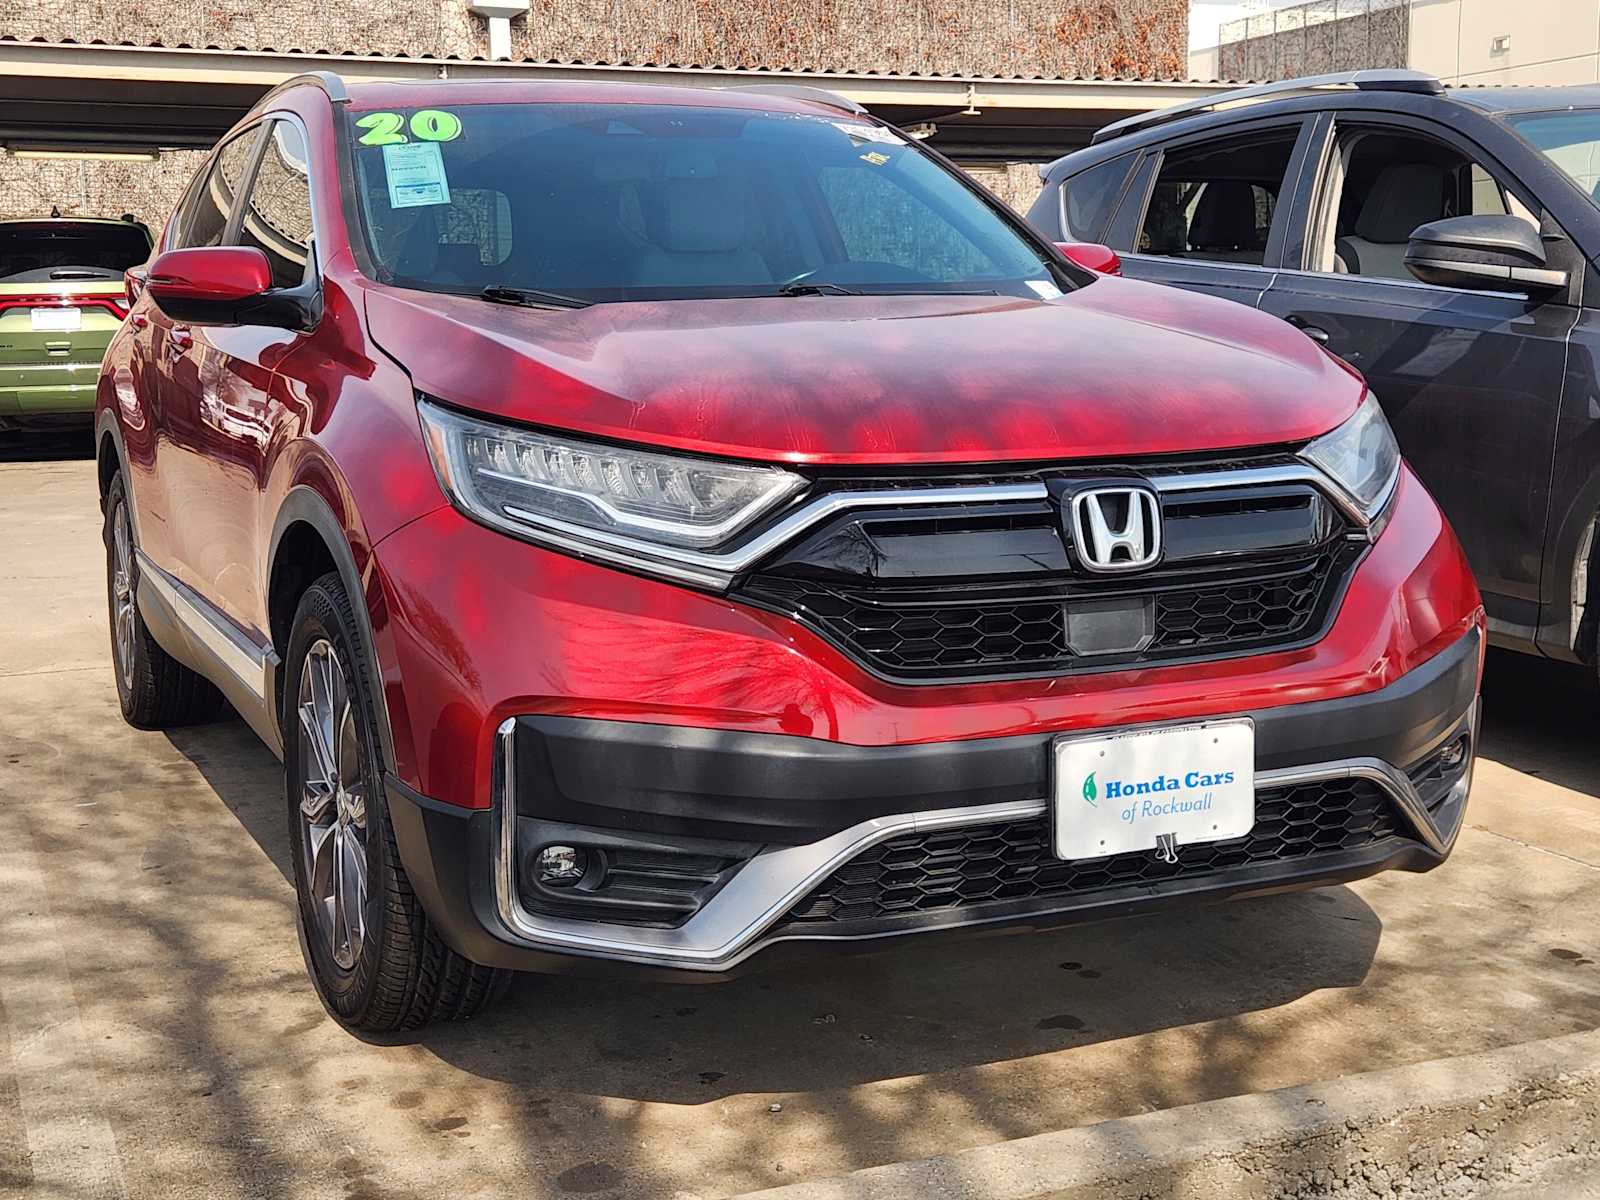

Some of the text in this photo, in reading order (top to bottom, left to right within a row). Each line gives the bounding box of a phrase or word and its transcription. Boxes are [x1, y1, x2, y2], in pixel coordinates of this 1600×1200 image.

[355, 110, 463, 146] 20
[1084, 490, 1146, 566] H
[1105, 771, 1235, 799] Honda Cars
[1121, 792, 1213, 825] of Rockwall
